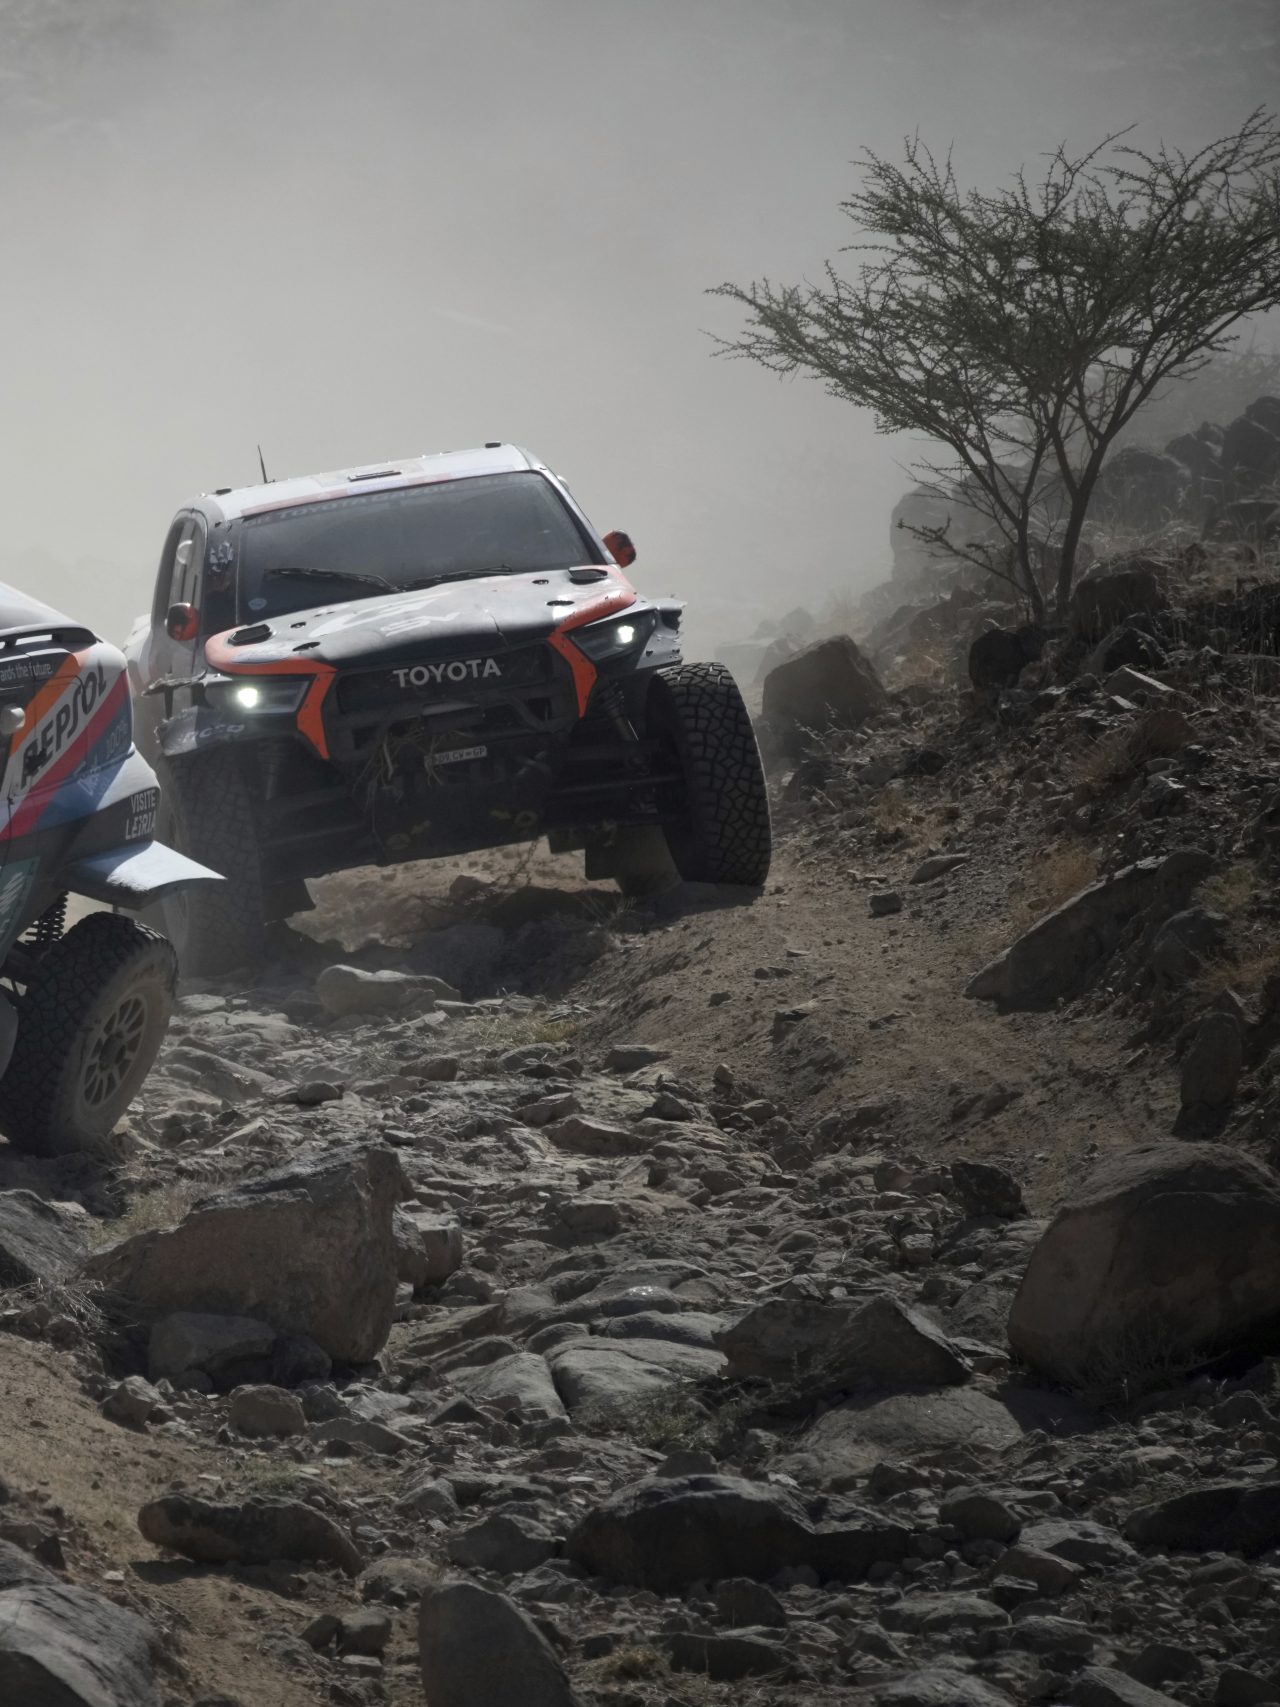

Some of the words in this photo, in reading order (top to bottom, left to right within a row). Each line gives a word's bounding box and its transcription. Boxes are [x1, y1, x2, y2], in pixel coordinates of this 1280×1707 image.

[392, 658, 503, 688] TOYOTA
[21, 659, 107, 790] REPSOL
[130, 788, 157, 814] VISITE
[125, 810, 157, 841] LEIRIA
